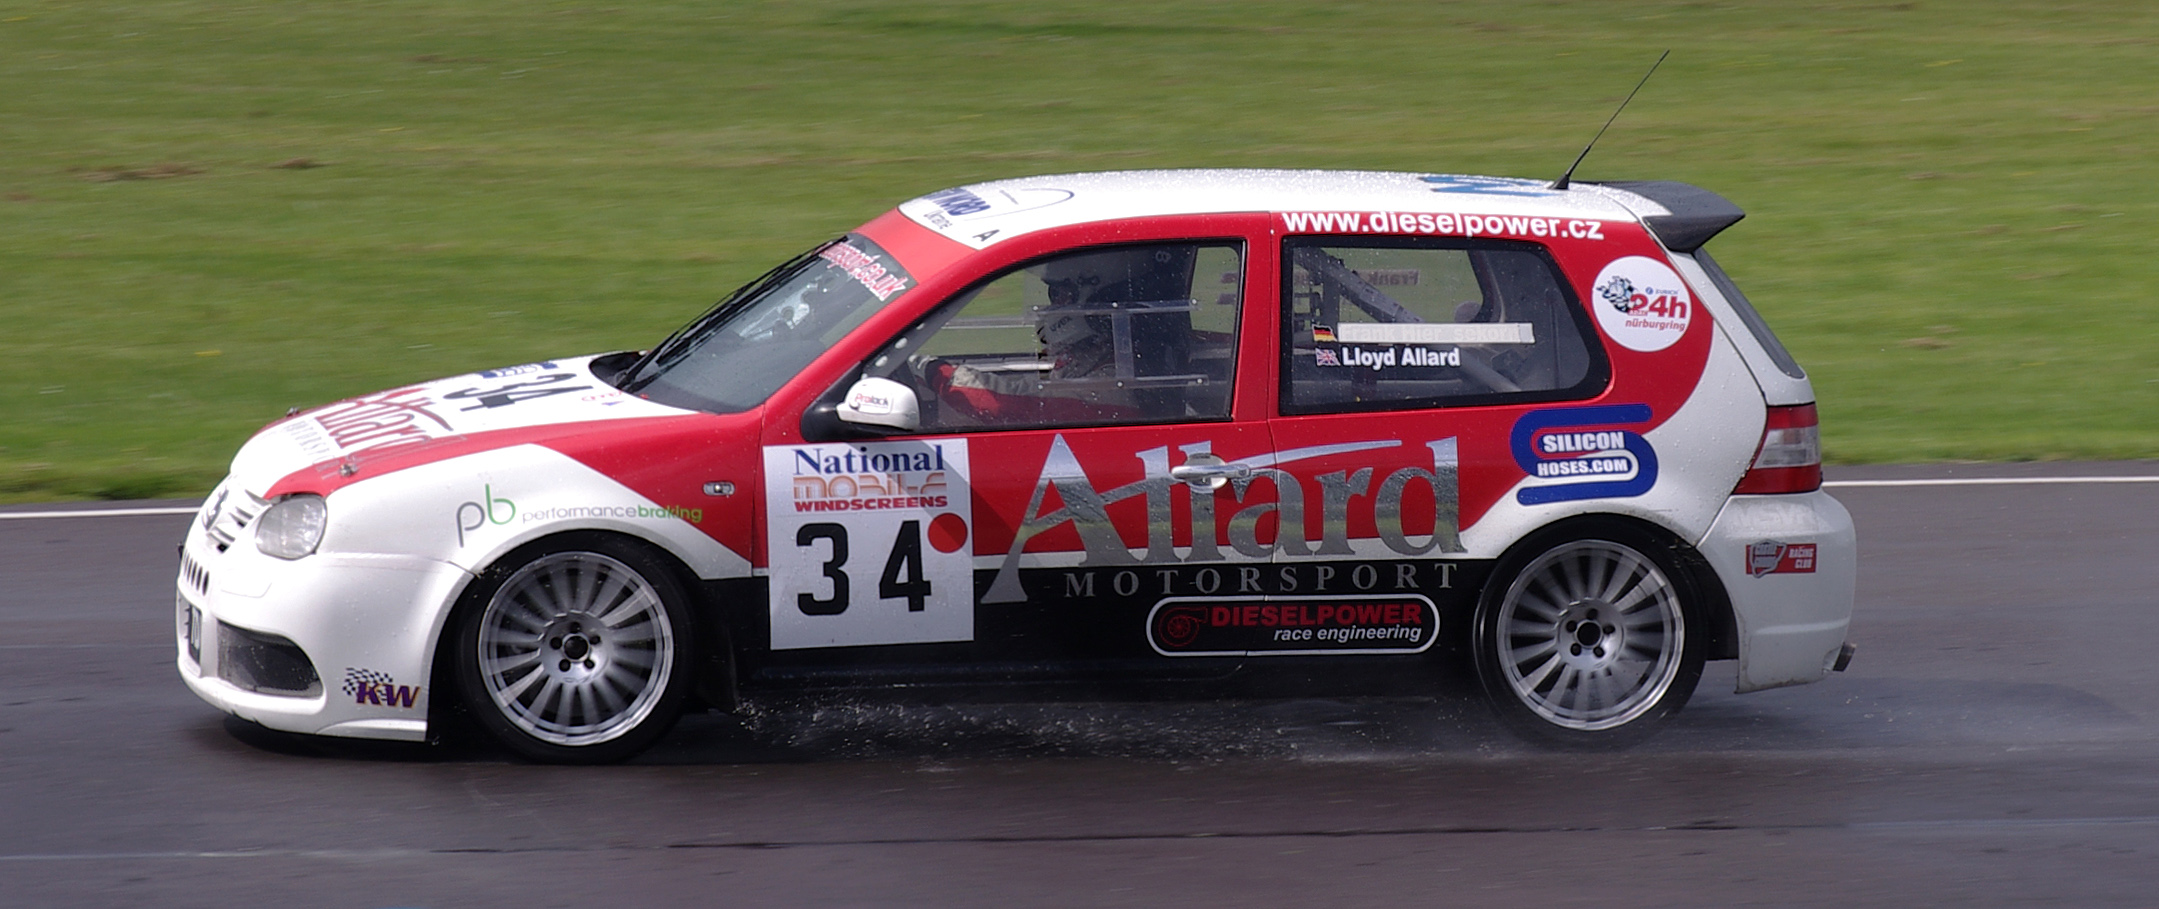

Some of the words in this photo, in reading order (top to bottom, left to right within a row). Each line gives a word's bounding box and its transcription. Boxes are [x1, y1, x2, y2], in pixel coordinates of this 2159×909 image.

[1281, 210, 1605, 241] www.dieselpower.cz
[1630, 293, 1687, 319] 24h
[1625, 318, 1686, 332] nürburgring
[1342, 347, 1396, 370] Lloyd
[1401, 347, 1461, 367] Allard
[1543, 431, 1626, 453] SILICON
[792, 444, 947, 476] National
[1537, 458, 1628, 477] HOSES.COM
[794, 495, 949, 512] WINDSCREENS
[979, 433, 1469, 605] Allard
[1064, 562, 1458, 598] MOTORSPORT
[1211, 603, 1423, 627] DIESELPOWER
[1273, 629, 1313, 642] race
[1317, 624, 1423, 644] engineering
[356, 680, 421, 709] KW
